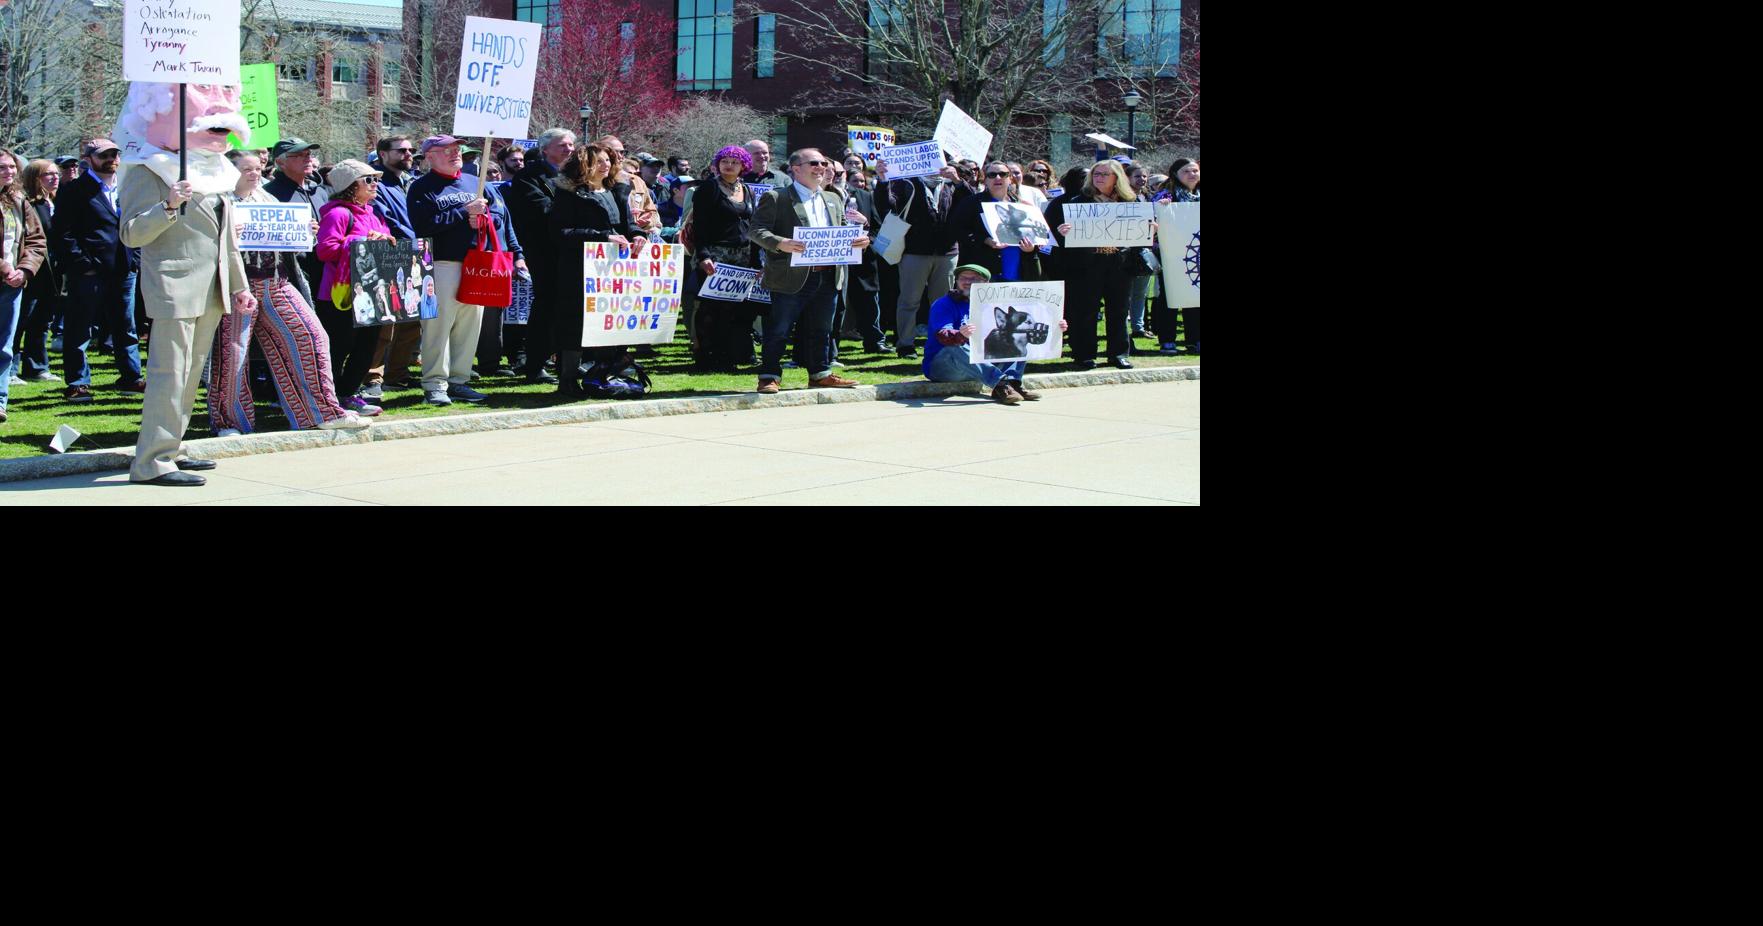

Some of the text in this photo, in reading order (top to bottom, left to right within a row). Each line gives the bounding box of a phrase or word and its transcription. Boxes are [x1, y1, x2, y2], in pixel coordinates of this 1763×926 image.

[141, 22, 198, 39] Arrogance
[144, 38, 186, 55] Tyranny
[472, 32, 527, 68] HANDS
[190, 61, 222, 75] Twain
[848, 131, 894, 143] HANDS OFF
[883, 148, 914, 157] UCONN
[914, 143, 939, 154] LABOR
[884, 155, 914, 165] STANDS
[916, 154, 926, 162] UP
[927, 152, 941, 160] FOR
[899, 161, 931, 171] UCONN
[250, 209, 298, 222] REPEAL
[1068, 203, 1140, 219] HANDS OFF
[244, 223, 306, 232] THE 5-YEAR PLAN
[798, 229, 860, 240] UCONN LABOR
[1073, 219, 1152, 240] HUSKIES!
[241, 231, 308, 242] STOP THE CUTS
[803, 240, 829, 248] TANDS
[831, 240, 842, 248] UP
[651, 244, 682, 260] OFF
[801, 247, 853, 258] RESEARCH
[594, 261, 677, 277] WOMEN'S
[714, 267, 756, 280] STAND UP FOR
[519, 288, 527, 296] UP
[585, 277, 678, 295] RIGHTS DEI
[708, 276, 751, 294] UCONN
[519, 297, 527, 321] STANDS
[586, 296, 679, 313] EDUCATION
[604, 314, 660, 330] BOOKZ
